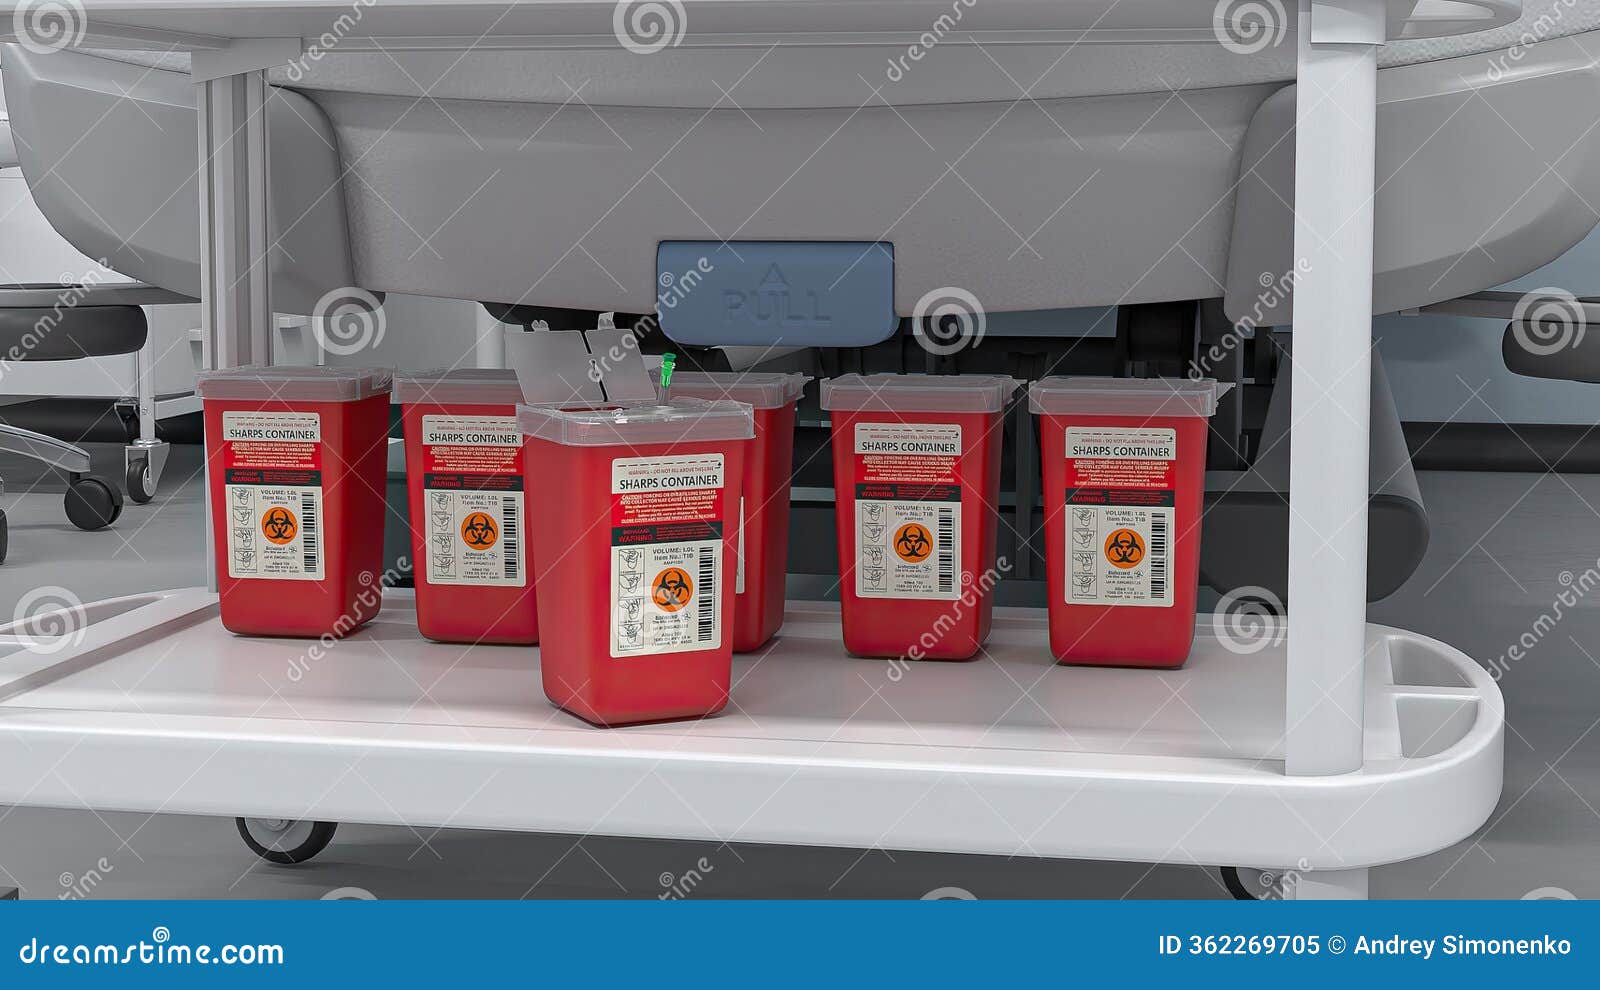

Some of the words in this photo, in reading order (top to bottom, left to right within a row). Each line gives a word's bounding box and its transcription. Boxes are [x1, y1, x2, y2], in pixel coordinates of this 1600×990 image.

[722, 289, 833, 323] PULL
[230, 429, 263, 438] SHARPS
[265, 430, 315, 439] CONTAINER
[430, 433, 464, 442] SHARPS
[466, 434, 518, 443] CONTAINER
[862, 442, 898, 451] SHARPS
[901, 442, 956, 452] CONTAINER
[1073, 446, 1110, 456] SHARPS
[1113, 446, 1170, 456] CONTAINER
[620, 477, 658, 490] SHARPS
[661, 474, 718, 488] CONTAINER
